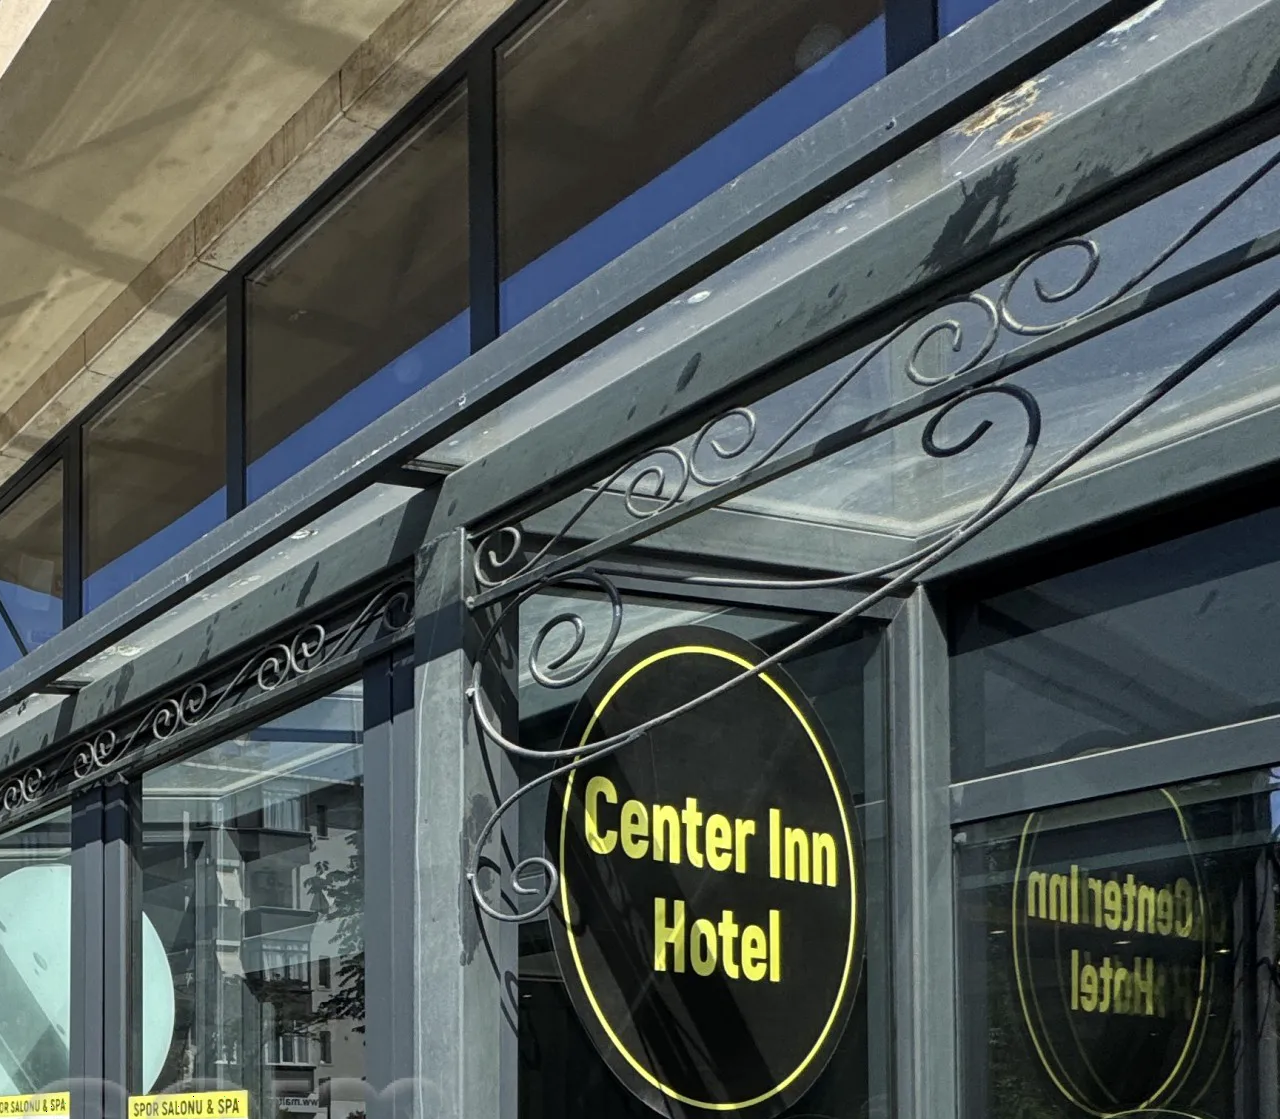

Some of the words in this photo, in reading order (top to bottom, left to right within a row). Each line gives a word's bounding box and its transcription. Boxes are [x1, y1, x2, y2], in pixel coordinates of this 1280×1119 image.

[585, 775, 755, 874] Center
[769, 808, 837, 888] Inn
[654, 897, 781, 983] Hotel
[10, 1099, 41, 1114] SALONU
[42, 1099, 48, 1112] &
[50, 1098, 66, 1112] SPA
[133, 1101, 160, 1118] SPOR
[161, 1099, 203, 1117] SALONU
[206, 1099, 214, 1115] &
[217, 1098, 240, 1114] SPA
